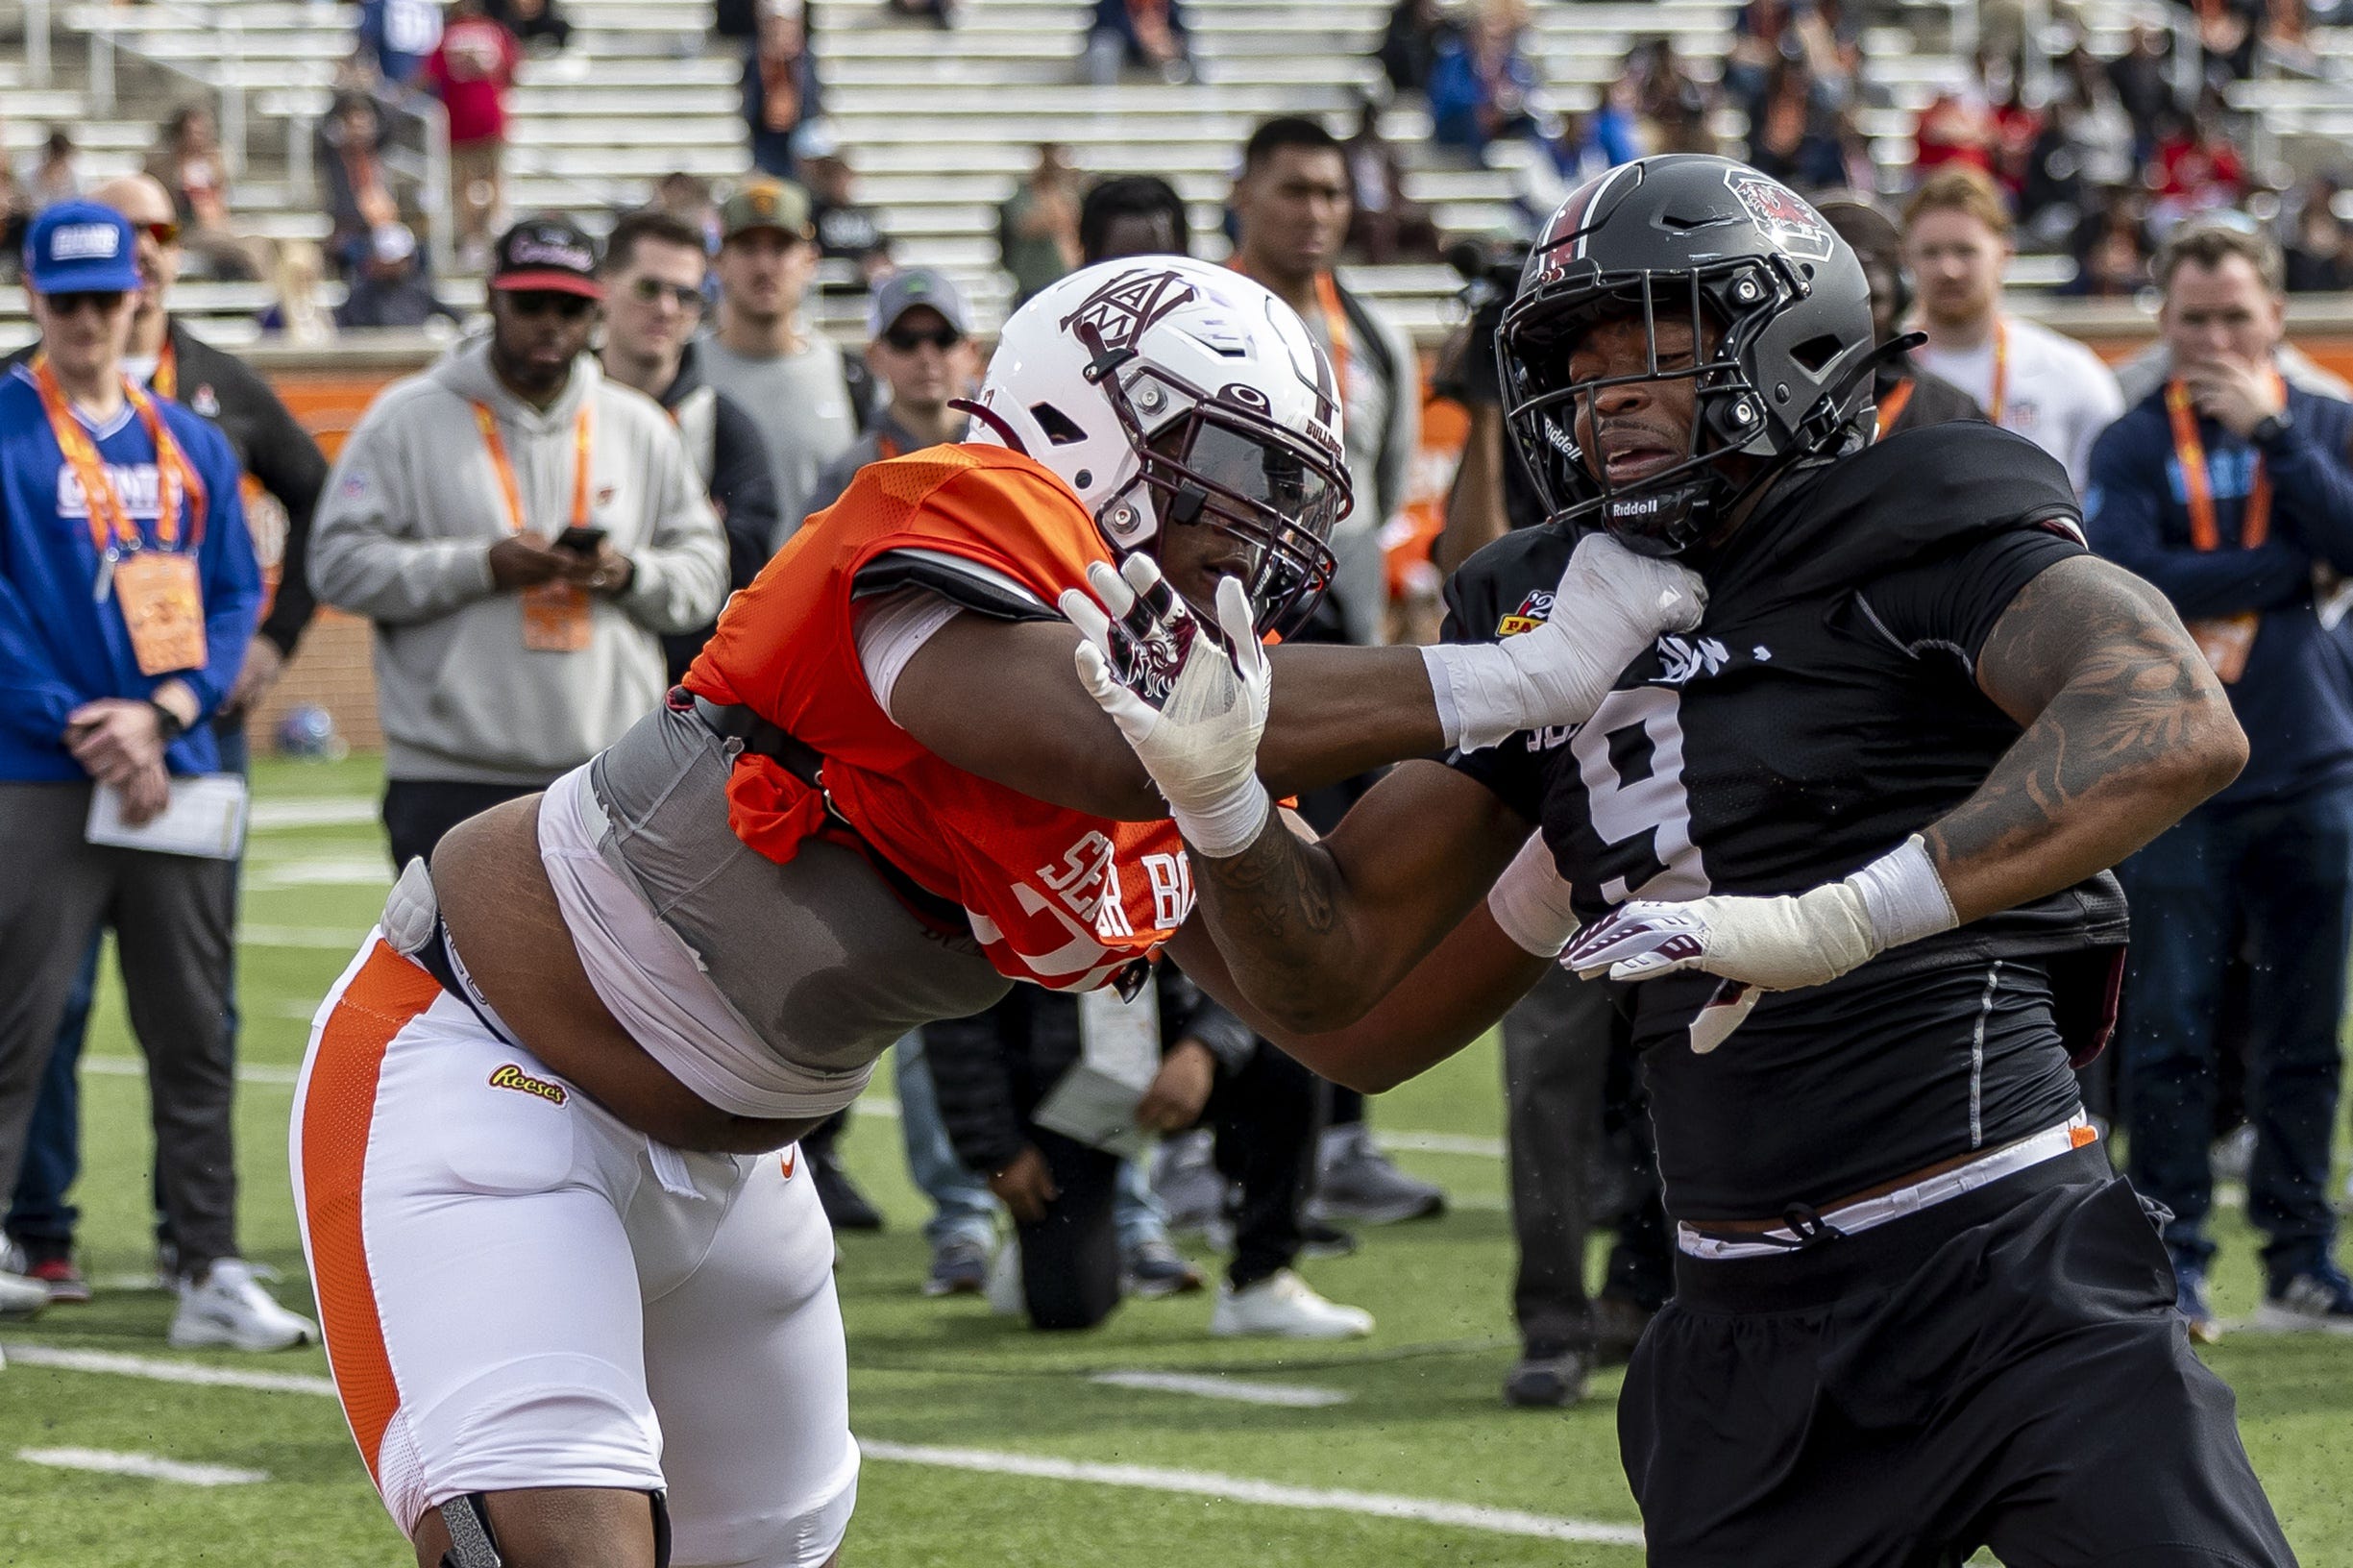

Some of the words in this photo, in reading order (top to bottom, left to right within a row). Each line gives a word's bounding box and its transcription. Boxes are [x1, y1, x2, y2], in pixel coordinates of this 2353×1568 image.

[1542, 416, 1583, 463] Riddell
[1613, 499, 1658, 518] Riddell
[1570, 686, 1712, 905] 9
[489, 1065, 565, 1104] Reese's
